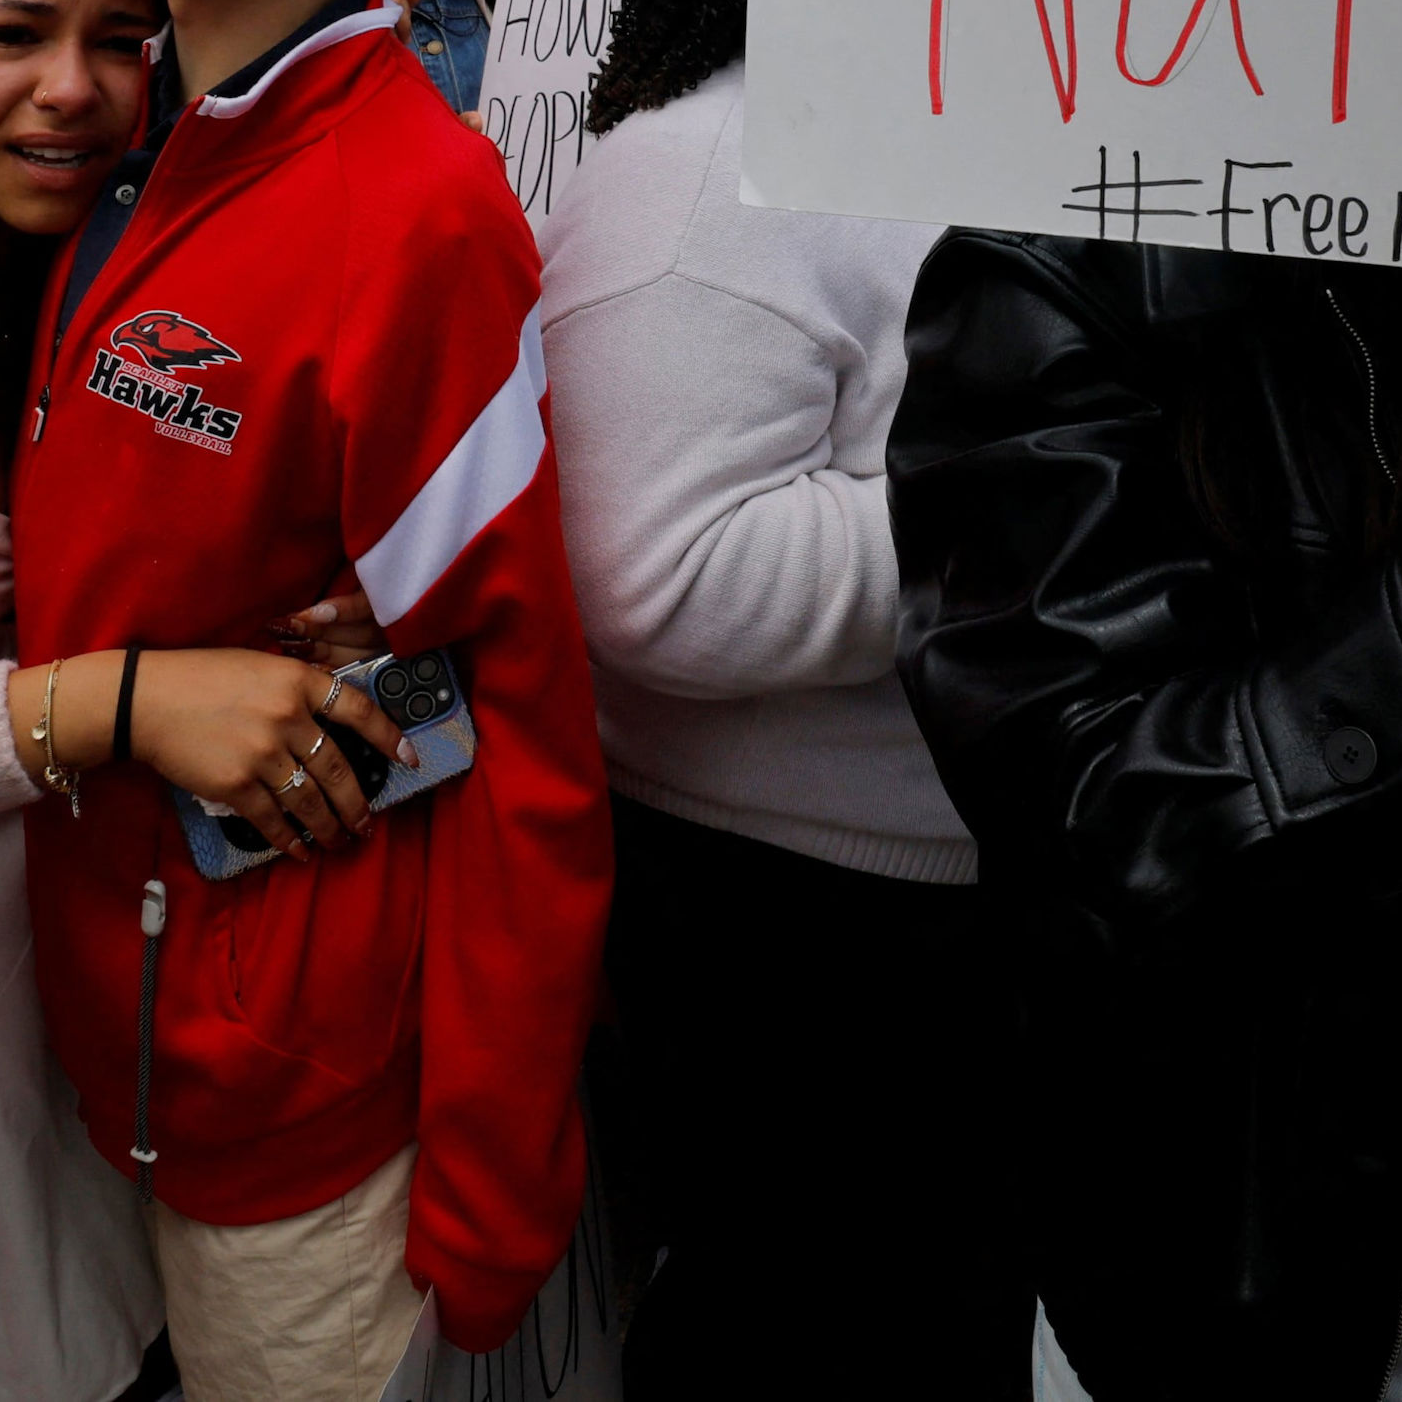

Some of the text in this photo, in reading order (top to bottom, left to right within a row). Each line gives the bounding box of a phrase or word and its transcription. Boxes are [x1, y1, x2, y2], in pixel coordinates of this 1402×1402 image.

[86, 348, 243, 441] Hawks
[121, 360, 185, 393] SCARLET
[154, 421, 233, 457] VOLLEYBALL
